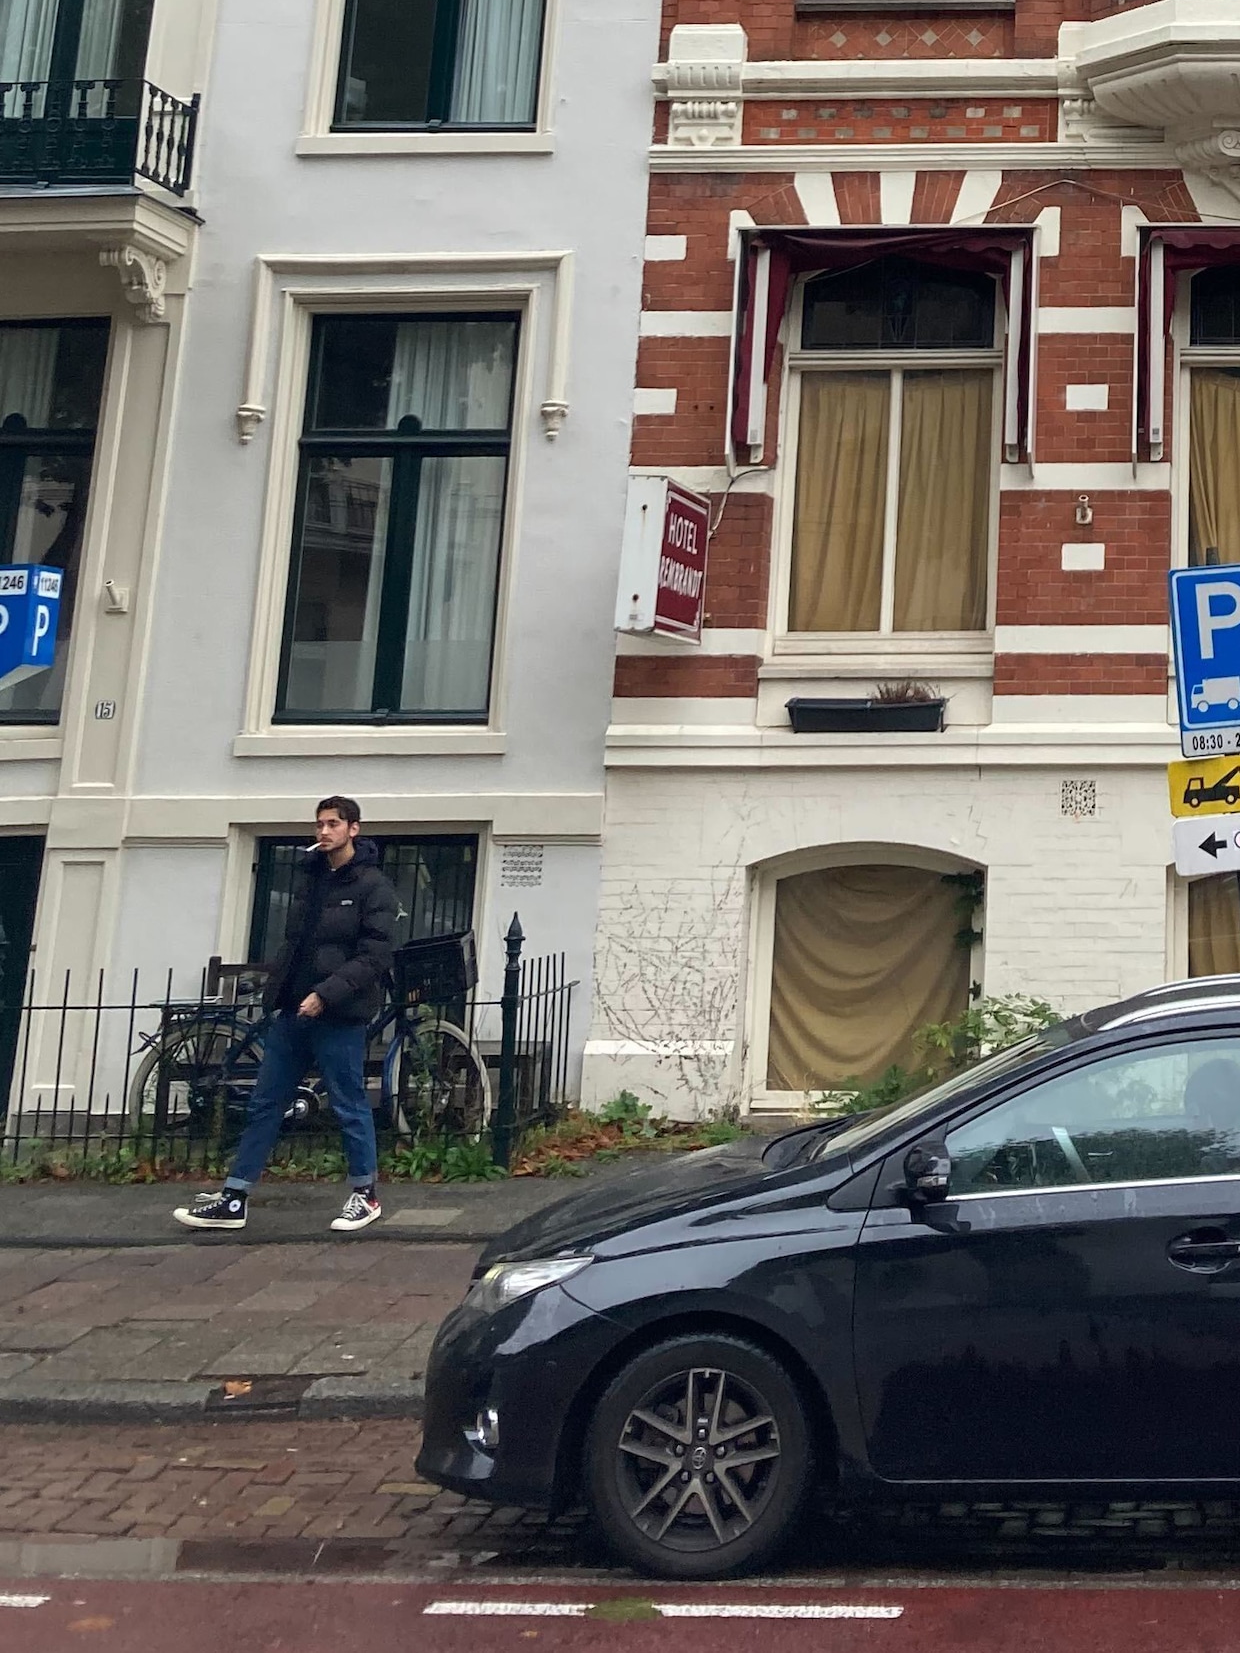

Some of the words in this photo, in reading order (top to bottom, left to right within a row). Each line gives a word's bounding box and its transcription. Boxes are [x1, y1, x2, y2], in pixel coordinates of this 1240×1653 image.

[668, 512, 698, 555] HOTEL
[0, 575, 25, 590] 246
[659, 555, 703, 599] REMBRANDT
[32, 604, 50, 656] P
[99, 701, 113, 718] 15
[1192, 734, 1224, 751] 08:30
